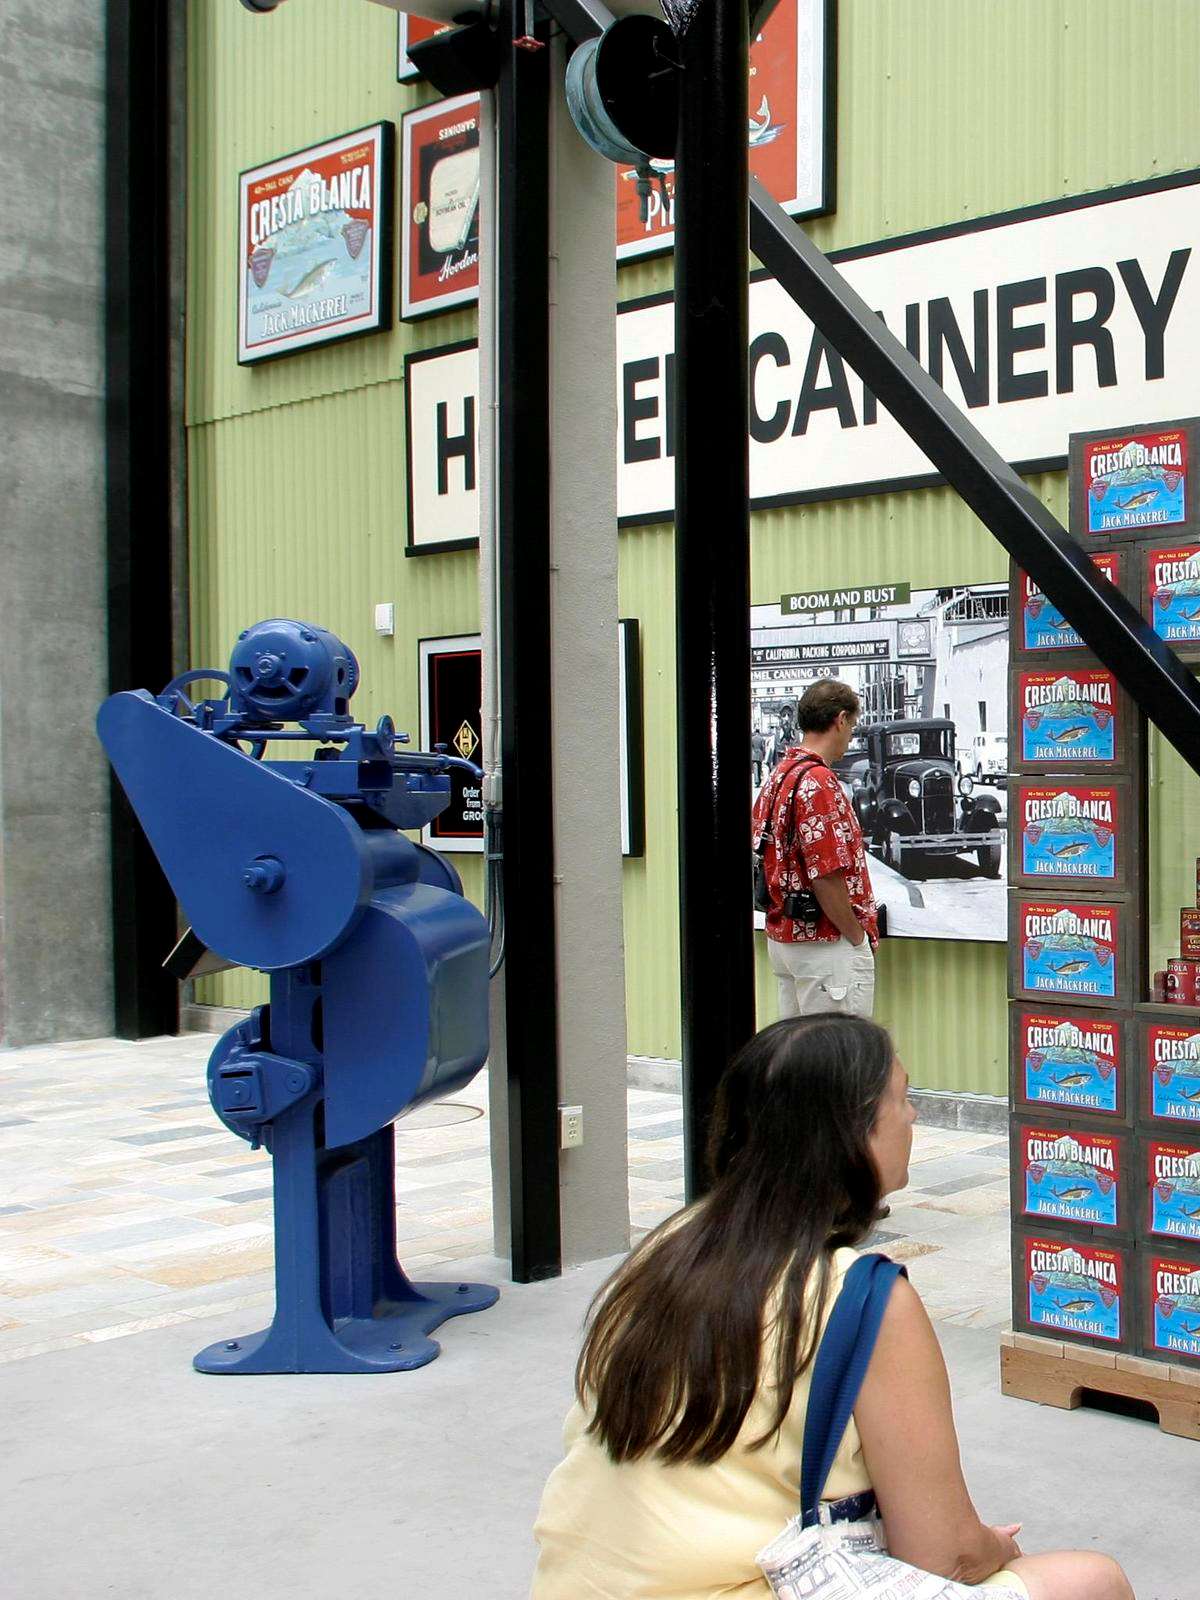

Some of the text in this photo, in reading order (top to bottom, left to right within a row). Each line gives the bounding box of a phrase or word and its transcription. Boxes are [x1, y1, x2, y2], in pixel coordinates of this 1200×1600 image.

[250, 165, 371, 246] CRESTA BLANCA
[261, 295, 347, 339] JACK MACKEREL
[1090, 443, 1182, 479] CRESTA BLANCA
[1101, 509, 1168, 528] JACK MACKEREL
[1154, 558, 1198, 587] CRESTA
[790, 587, 896, 611] BOOM AND BUST
[1165, 625, 1187, 639] JACK
[765, 649, 800, 660] CALIFORNIA
[802, 646, 829, 658] PACKING
[832, 643, 875, 657] CORPORATION
[752, 671, 771, 680] MEL
[774, 667, 813, 679] CANNING
[1024, 682, 1112, 708] CRESTA BLANCA
[1034, 745, 1098, 758] JACK MACKEREL
[1024, 799, 1112, 823] CRESTA BLANCA
[1025, 914, 1112, 943] CRESTA BLANCA
[1027, 1025, 1114, 1057] CRESTA BLANCA
[1154, 1038, 1198, 1062] CRESTA
[1027, 1138, 1114, 1171] CRESTA BLANCA
[1154, 1154, 1198, 1179] CRESTA
[1030, 1249, 1117, 1286] CRESTA BLANCA
[1156, 1270, 1199, 1295] CRESTA
